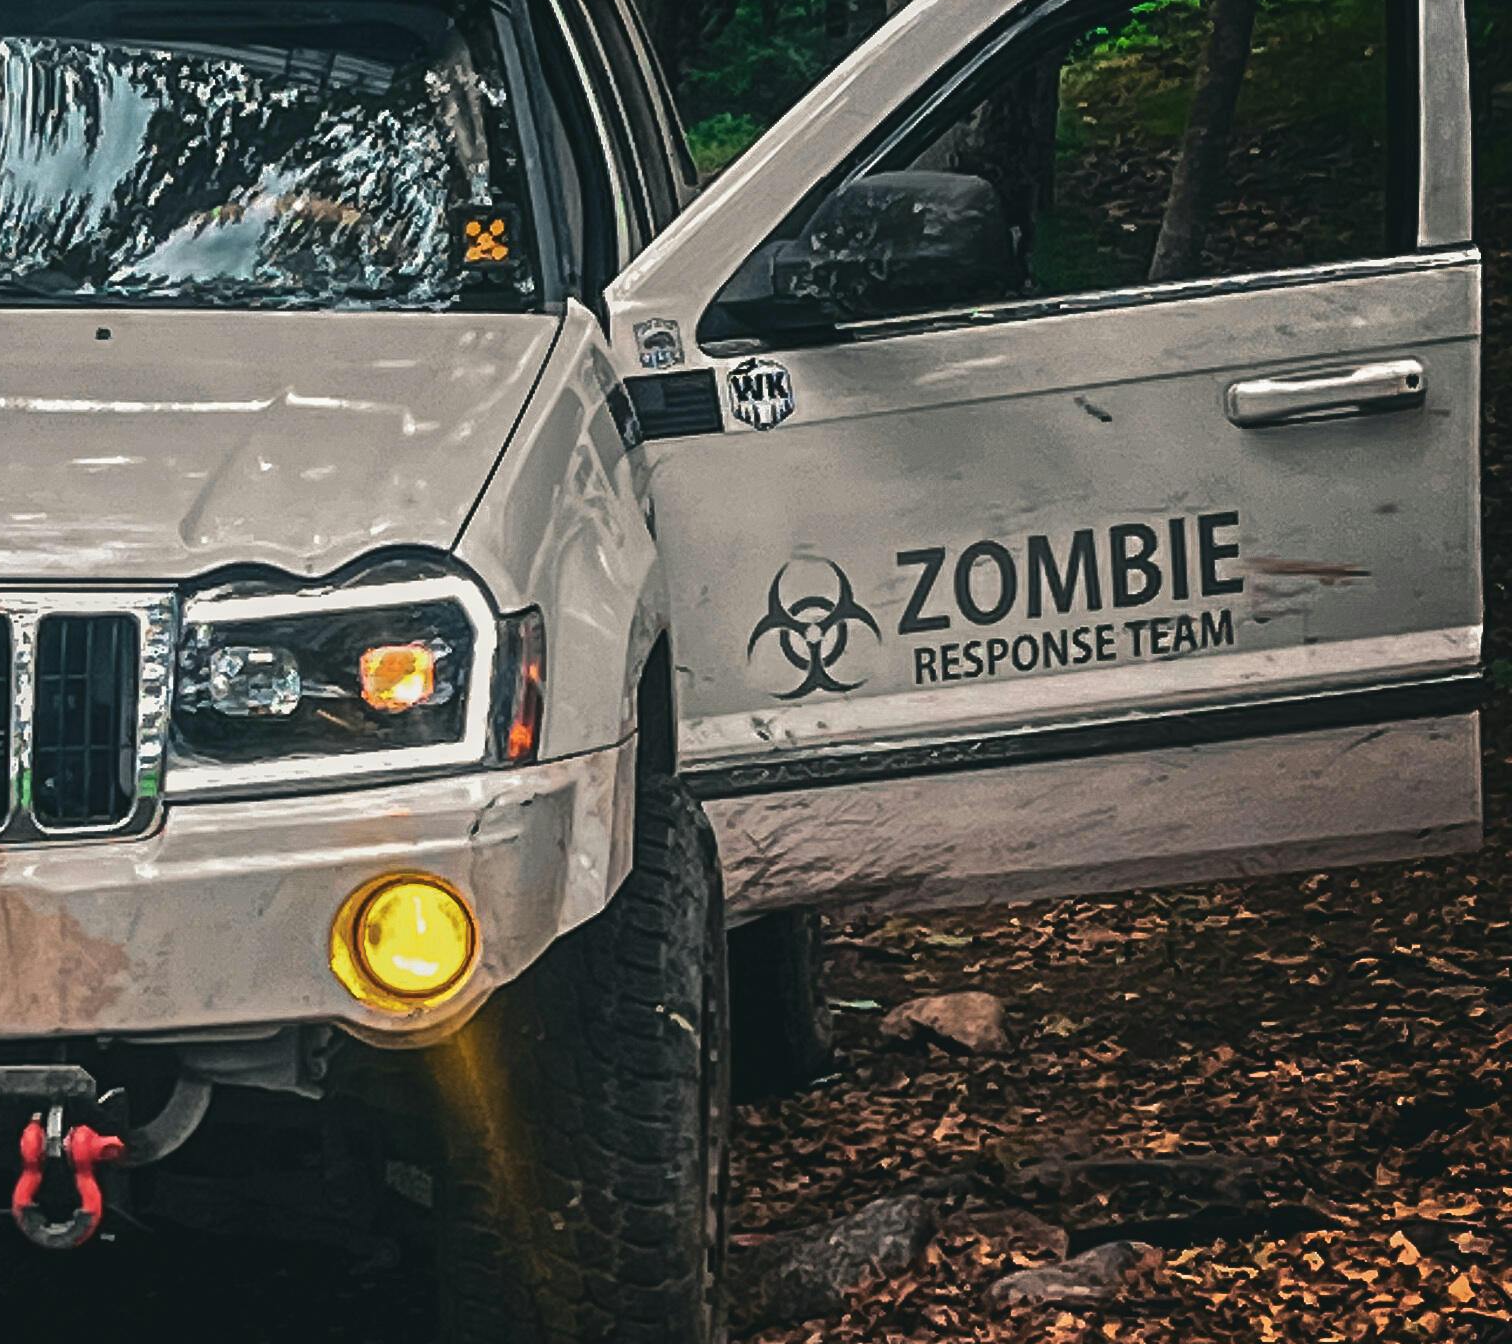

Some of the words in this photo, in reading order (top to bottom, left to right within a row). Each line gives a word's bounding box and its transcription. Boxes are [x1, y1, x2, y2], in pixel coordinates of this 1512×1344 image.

[732, 373, 789, 401] WK
[895, 510, 1244, 635] ZOMBIE
[914, 623, 1118, 685] RESPONSE
[1124, 609, 1235, 658] TEAM
